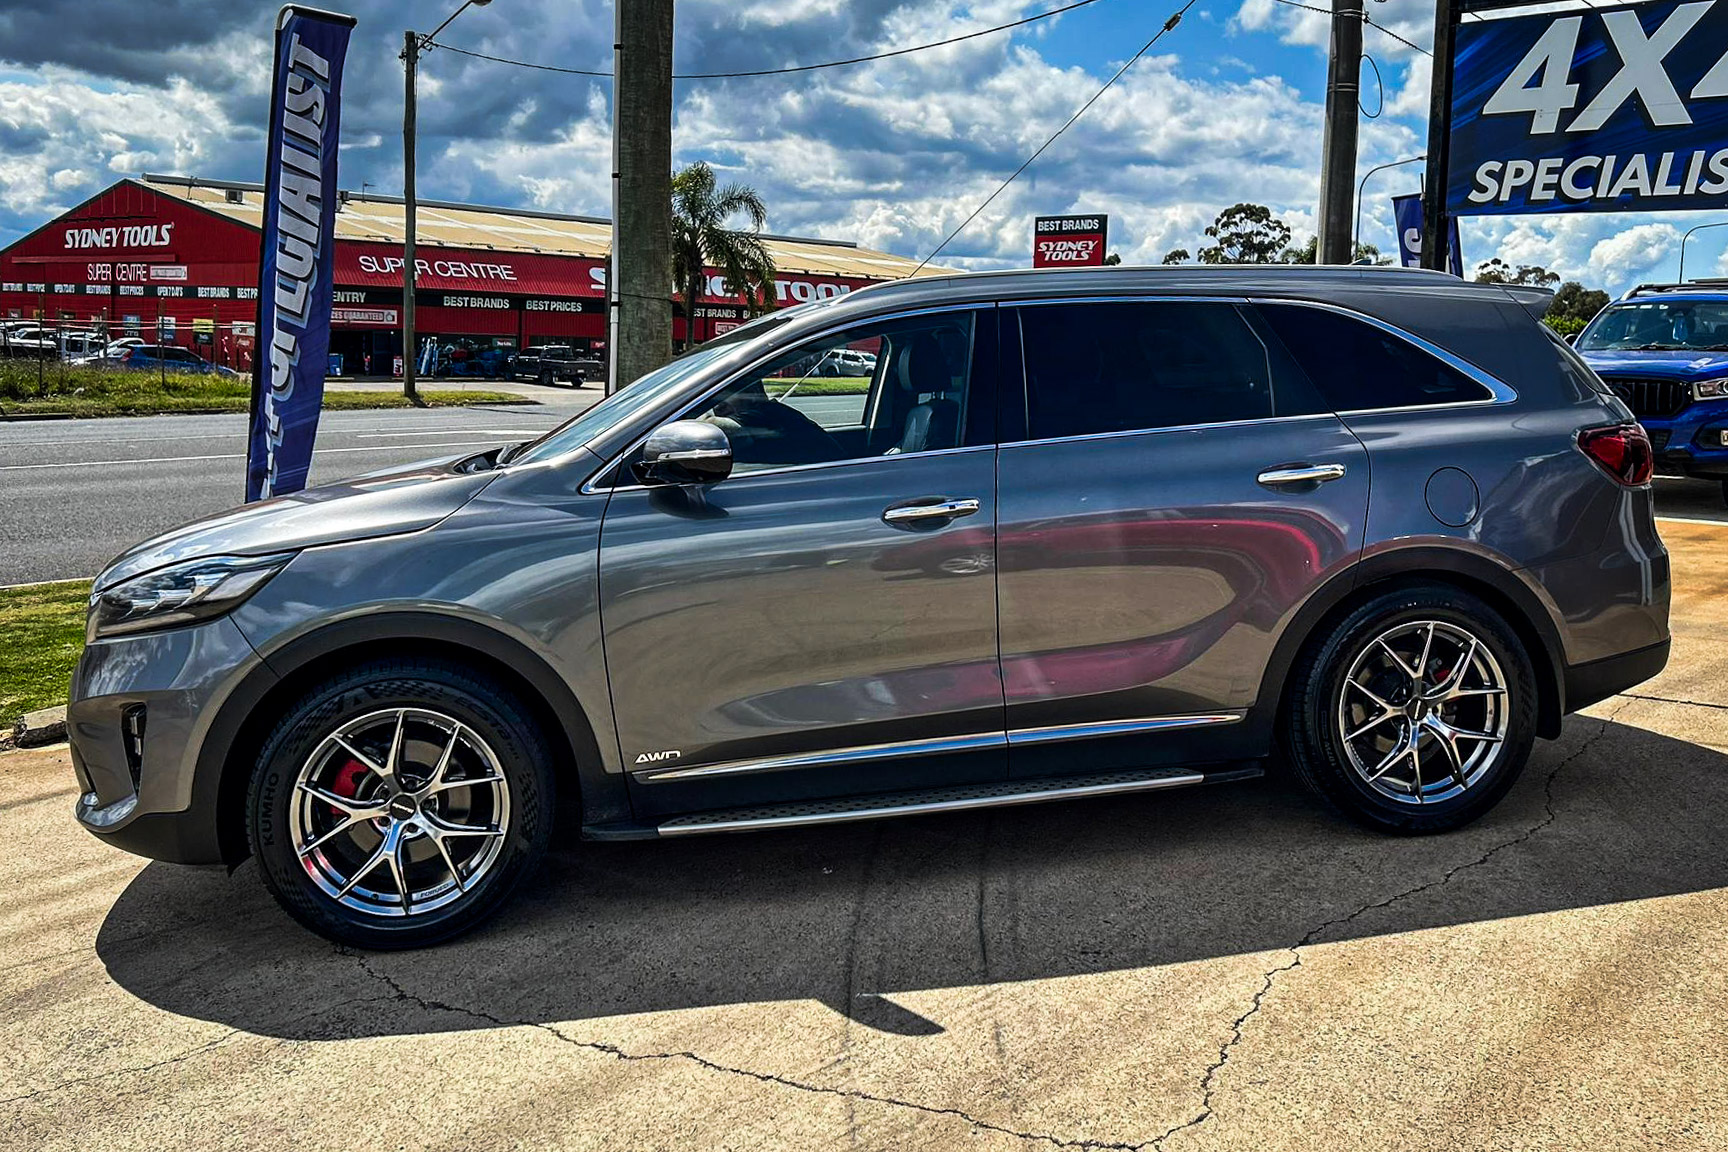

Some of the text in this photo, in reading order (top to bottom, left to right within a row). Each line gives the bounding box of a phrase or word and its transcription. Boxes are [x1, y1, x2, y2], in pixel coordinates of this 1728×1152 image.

[1467, 149, 1728, 204] SPECIALIS
[1037, 219, 1099, 231] BEST BRANDS
[64, 224, 172, 249] SYDNEY TOOLS
[1038, 240, 1098, 261] SYDNEY TOOLS
[87, 263, 112, 281] SUPER
[115, 263, 147, 281] CENTRE
[434, 260, 518, 280] CENTRE
[197, 287, 230, 298] BEST BRANDS
[237, 288, 250, 299] BEST
[333, 291, 366, 303] ENTRY
[443, 296, 510, 309] BEST BRANDS
[526, 300, 582, 312] BEST PRICES
[707, 308, 737, 318] BRANDS
[634, 750, 681, 764] AWD
[263, 772, 281, 846] KUMHO
